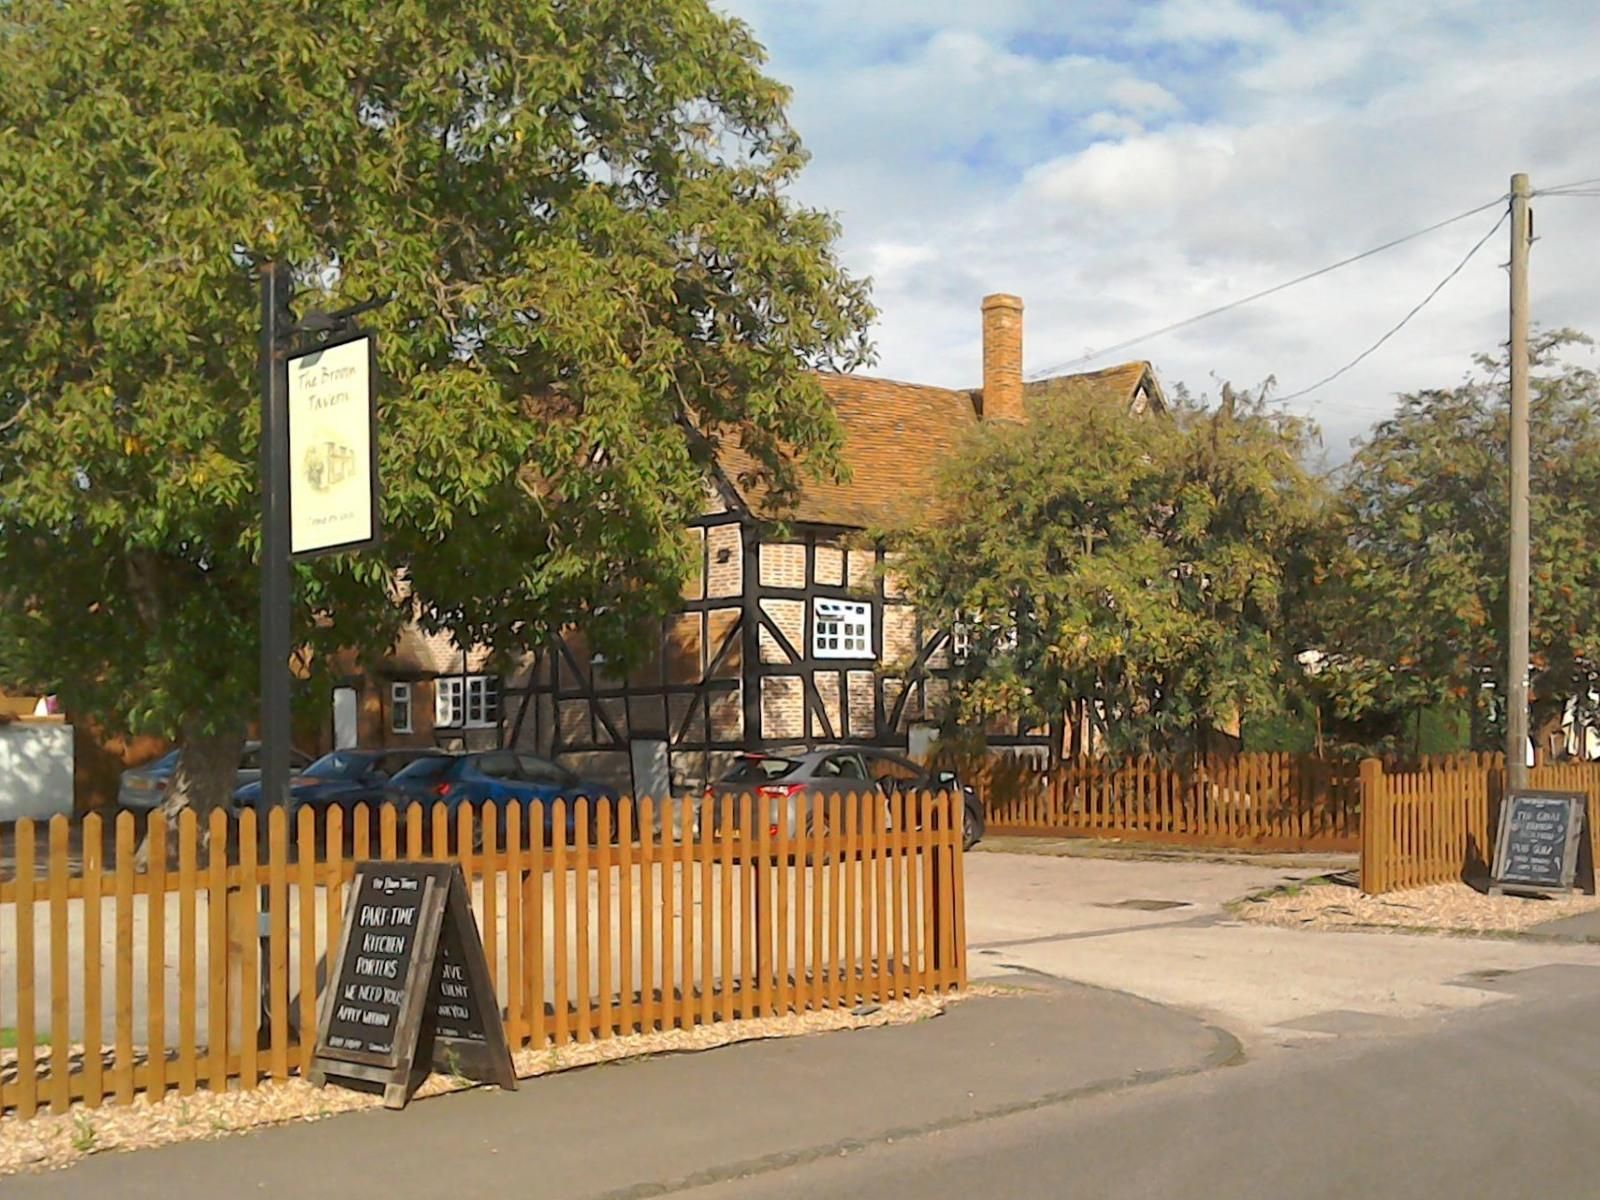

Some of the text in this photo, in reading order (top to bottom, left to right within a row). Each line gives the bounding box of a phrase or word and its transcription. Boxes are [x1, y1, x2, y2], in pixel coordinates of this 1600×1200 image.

[363, 932, 405, 954] KITCHEN
[356, 957, 398, 978] PORTERS
[358, 985, 383, 1002] NEED
[337, 1005, 362, 1022] APPLY
